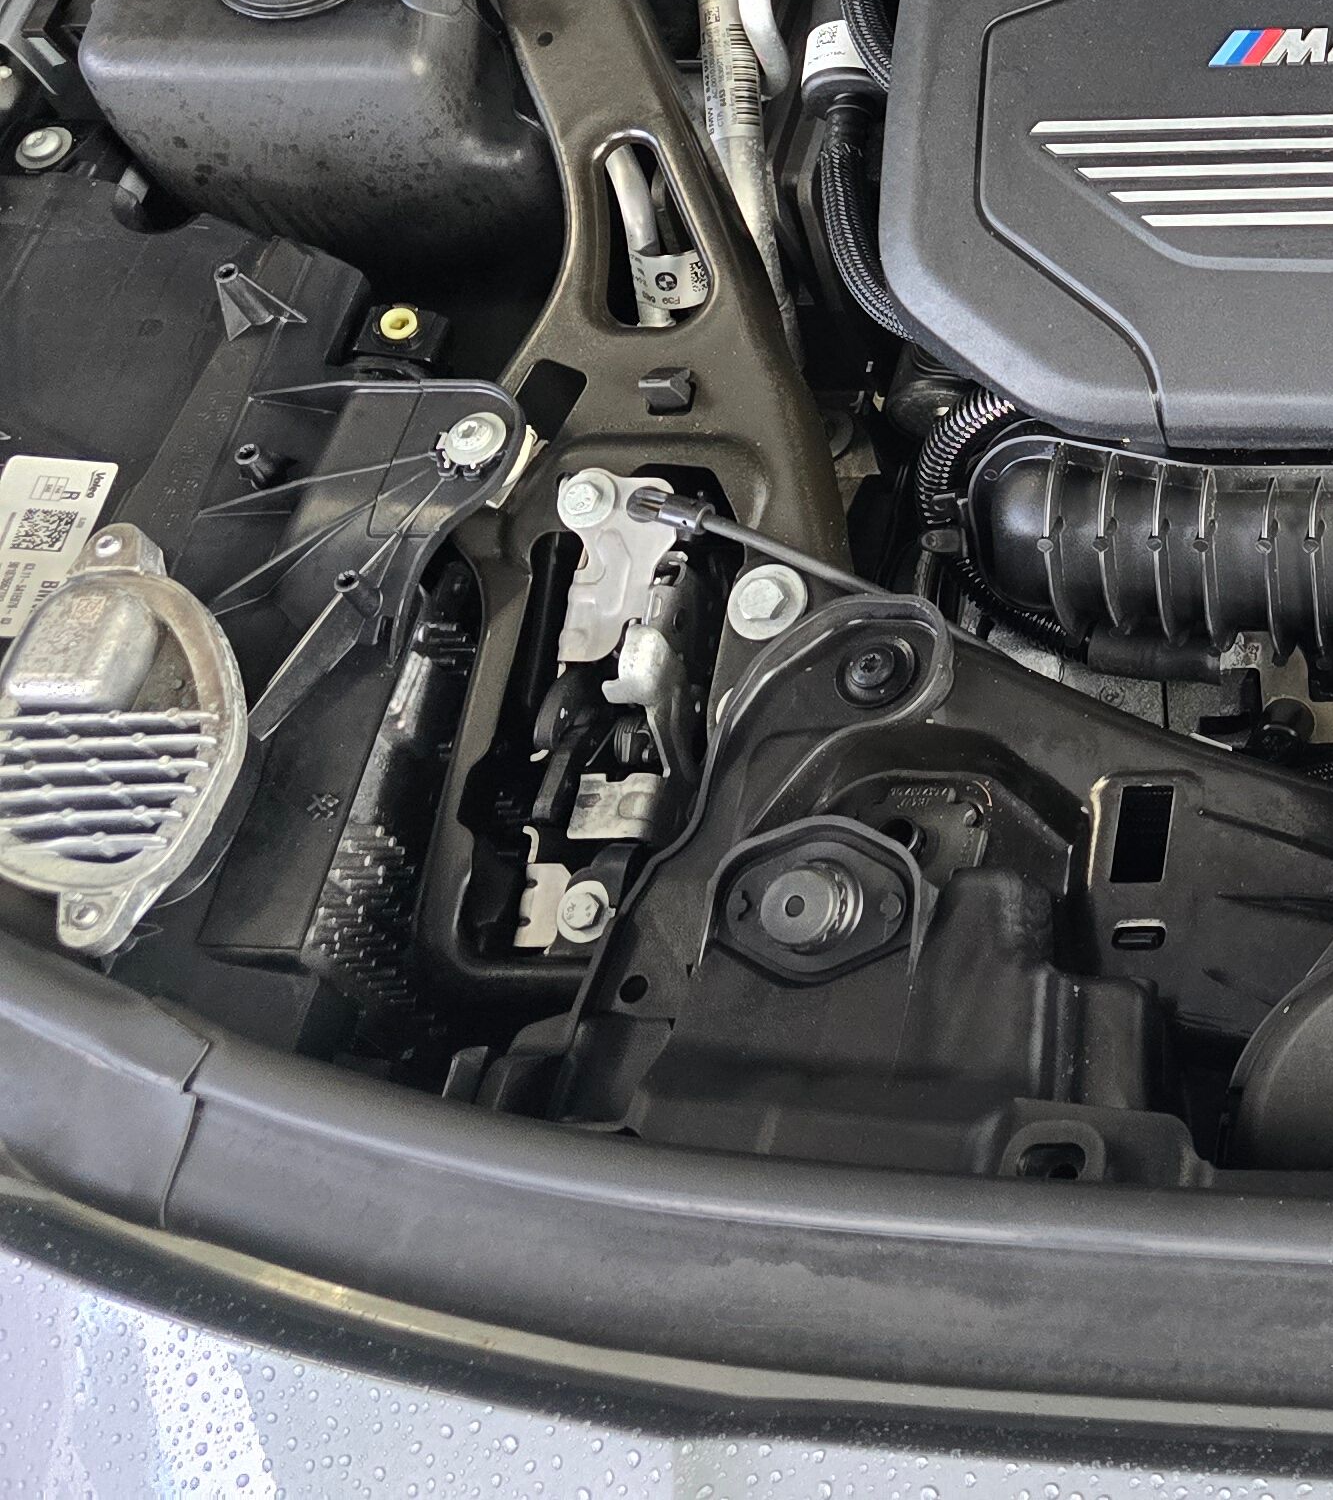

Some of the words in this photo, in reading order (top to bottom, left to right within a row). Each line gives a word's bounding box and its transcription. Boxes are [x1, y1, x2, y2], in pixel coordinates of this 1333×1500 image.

[662, 295, 680, 305] F39
[86, 471, 107, 499] Valeo
[63, 490, 81, 501] R
